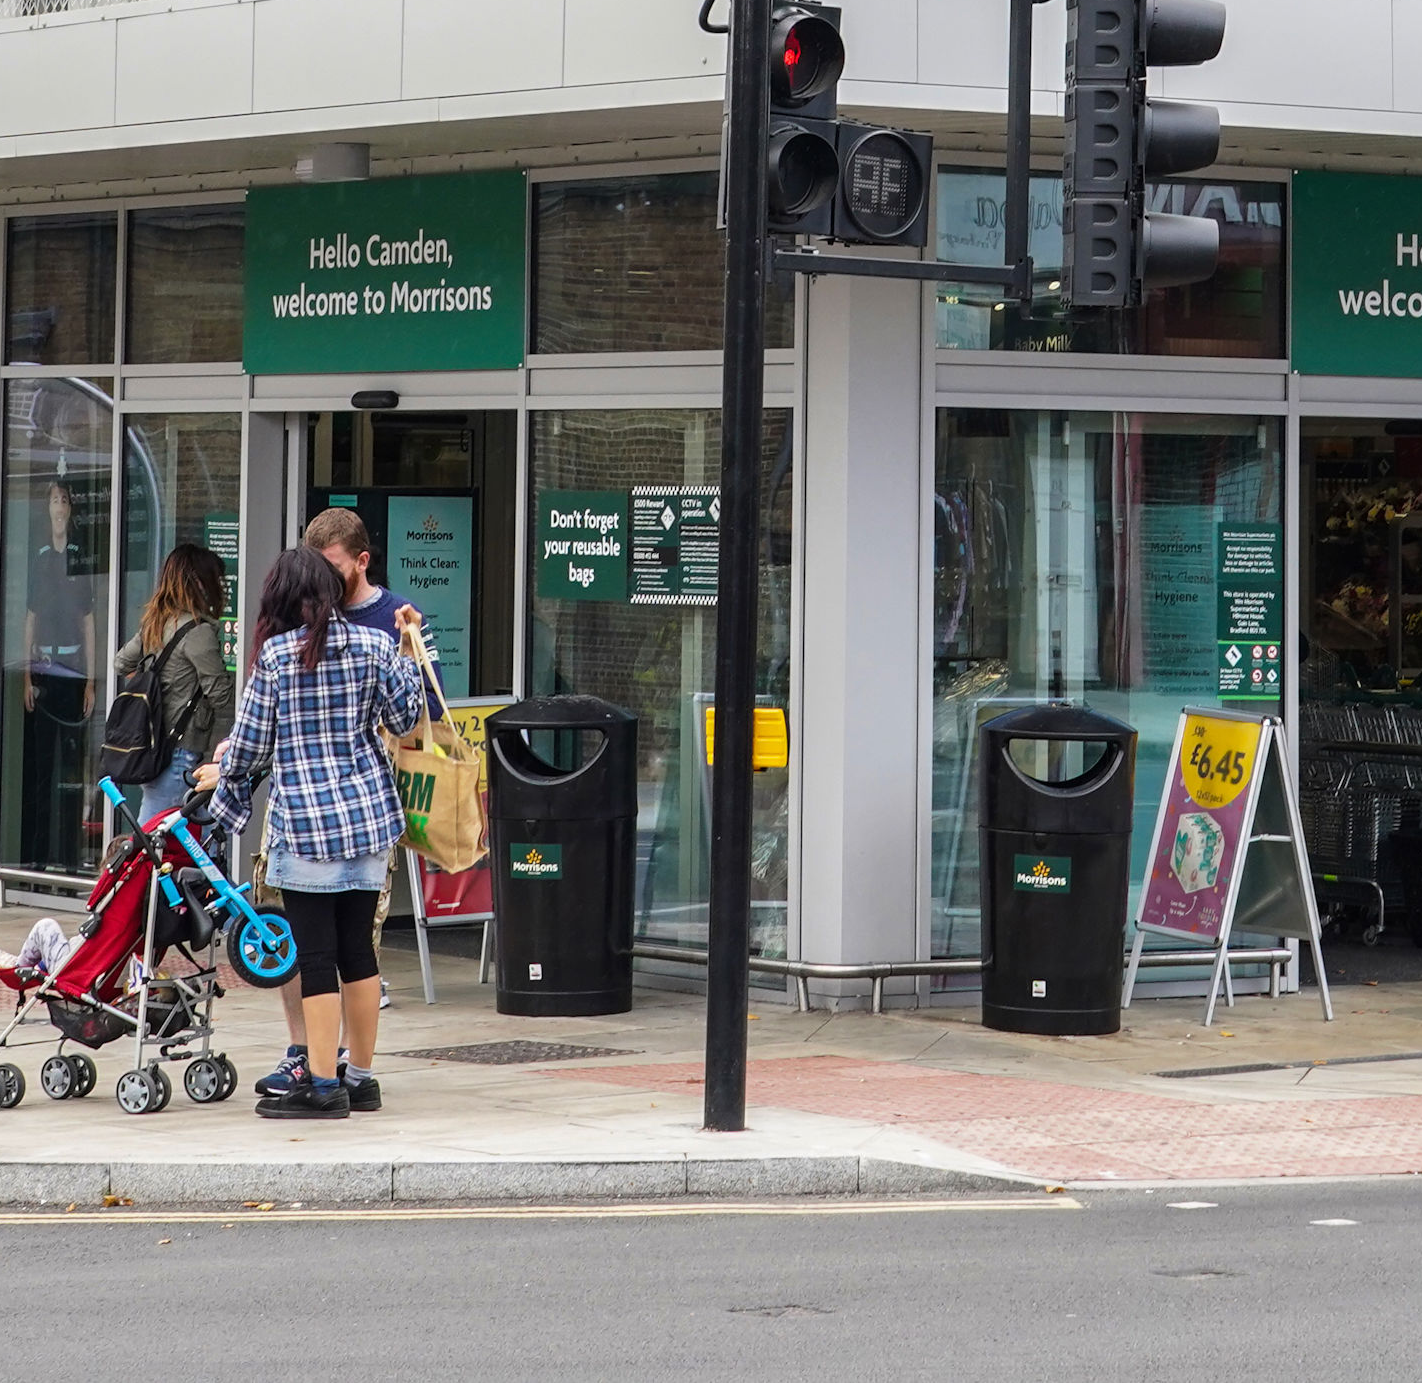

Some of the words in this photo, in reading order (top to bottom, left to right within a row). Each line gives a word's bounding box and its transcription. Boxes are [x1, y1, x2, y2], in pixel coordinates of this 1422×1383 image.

[310, 233, 361, 270] Hello
[366, 228, 453, 268] Camden,
[273, 282, 359, 318] welcome
[363, 285, 386, 314] to
[390, 278, 492, 314] Morrisons
[1045, 335, 1072, 352] Milk
[681, 499, 696, 507] CCTV
[550, 509, 582, 529] Don't
[583, 509, 620, 534] forget
[406, 530, 453, 541] Morrisons
[544, 539, 571, 559] your
[572, 536, 621, 557] reusable
[400, 558, 427, 569] Think
[429, 558, 460, 569] Clean:
[409, 575, 450, 588] Hygiene
[568, 562, 595, 588] bags
[1155, 590, 1198, 605] Hygiene
[472, 716, 482, 732] 2
[1190, 742, 1247, 785] £6.45
[396, 767, 436, 814] RM
[513, 861, 558, 872] Morrisons
[1017, 873, 1067, 886] Morrisons
